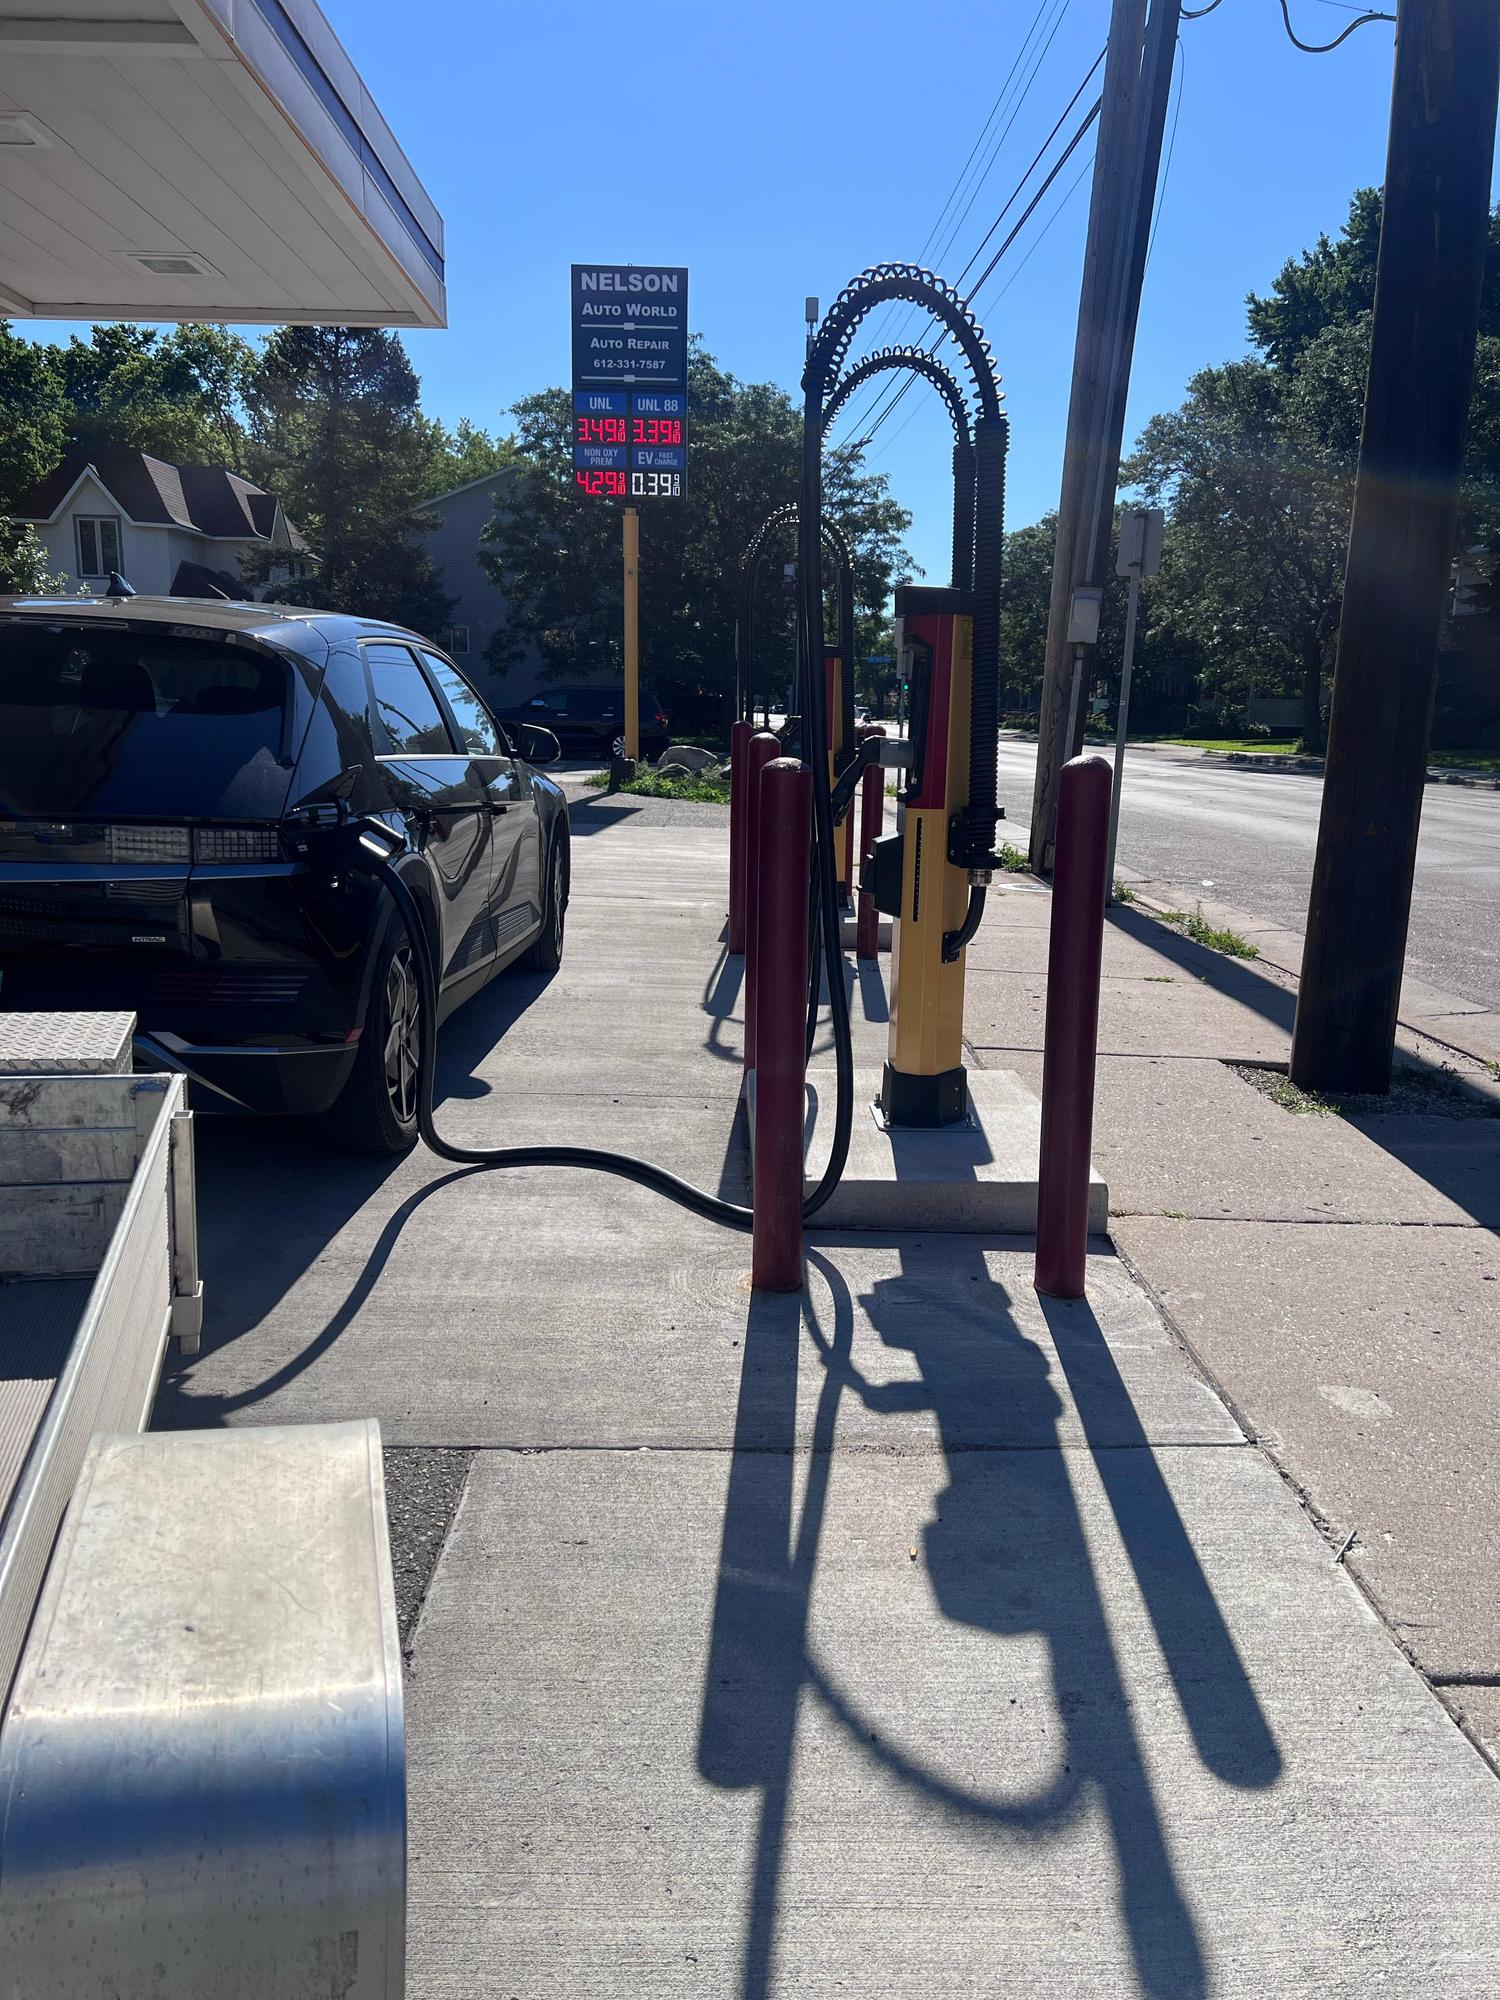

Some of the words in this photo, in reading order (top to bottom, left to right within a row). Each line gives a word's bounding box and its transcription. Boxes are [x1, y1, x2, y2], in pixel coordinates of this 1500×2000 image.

[581, 272, 678, 292] NELSON
[582, 303, 621, 316] AUTO
[626, 303, 677, 317] WORLD
[590, 338, 623, 349] AUTO
[627, 338, 670, 350] REPAIR
[593, 359, 666, 369] 612-331-7587
[589, 397, 613, 410] UNL
[638, 399, 661, 411] UNL
[664, 399, 679, 412] 88
[584, 448, 601, 457] NON
[603, 449, 619, 458] OXY
[638, 452, 654, 465] EV
[590, 457, 613, 466] PREM
[654, 458, 679, 466] CHARGE
